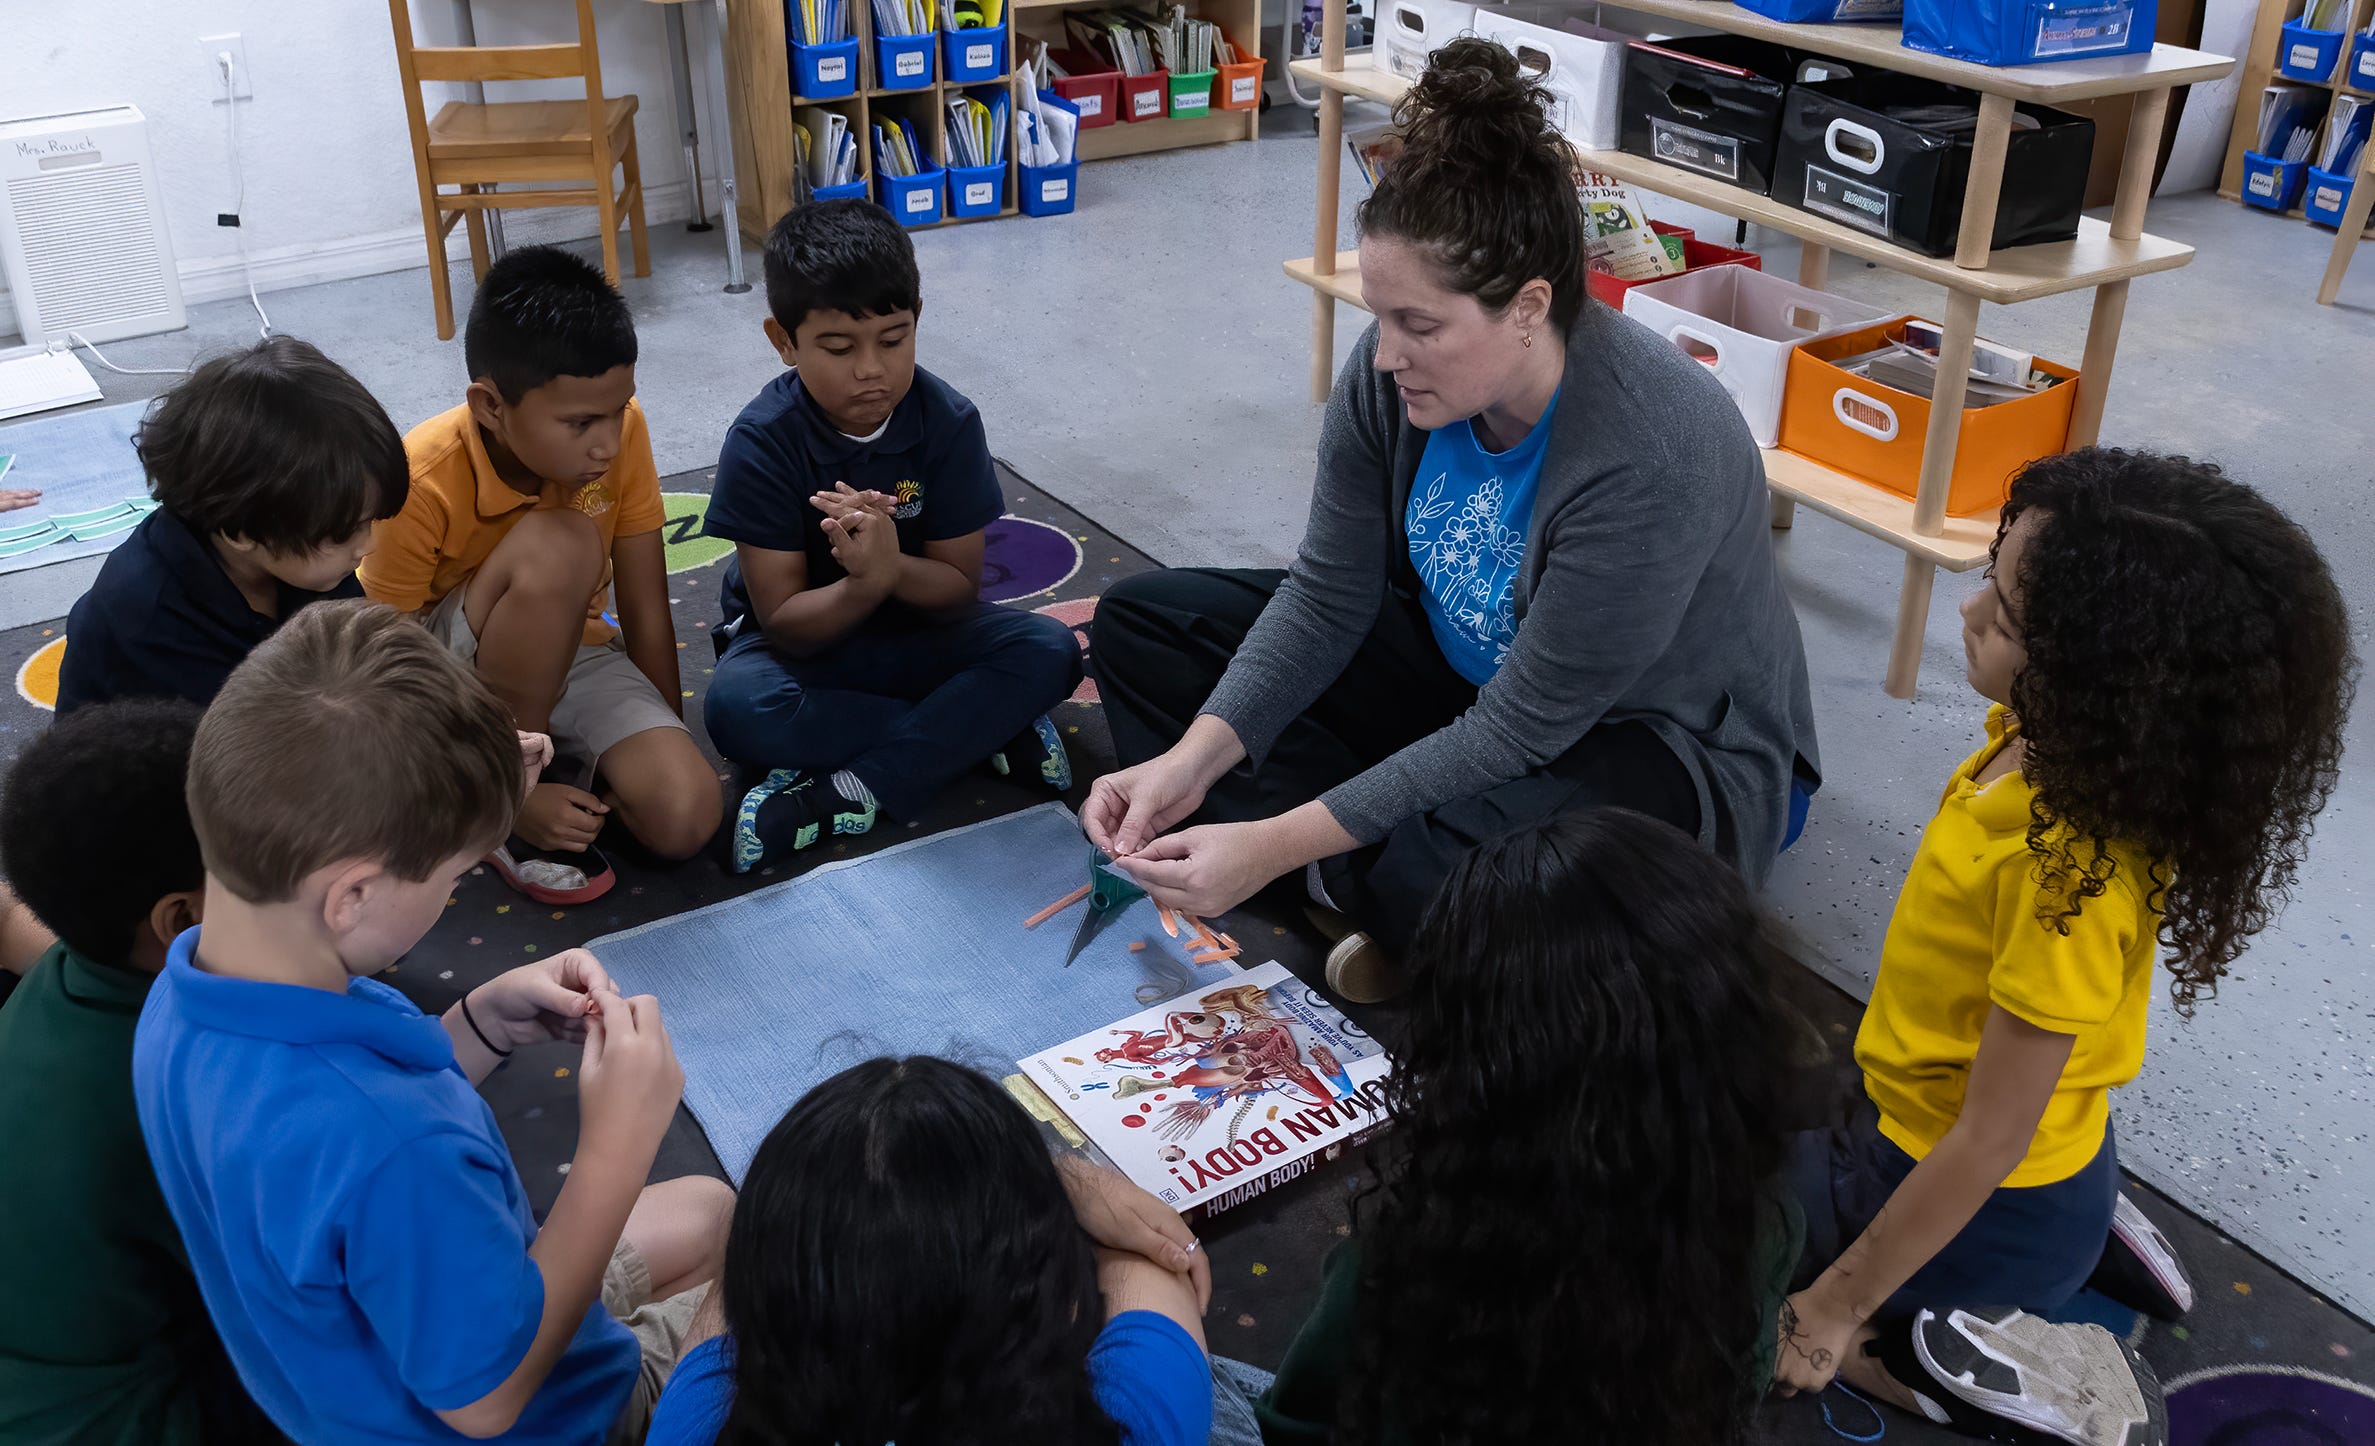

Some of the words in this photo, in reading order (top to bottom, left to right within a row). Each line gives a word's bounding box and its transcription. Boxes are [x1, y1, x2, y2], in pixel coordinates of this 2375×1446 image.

[16, 143, 45, 157] Mrs.
[48, 136, 96, 154] Rauck
[1602, 188, 1626, 199] Dog
[1282, 1001, 1299, 1015] BODY
[1299, 1005, 1316, 1020] SEEN
[1297, 1012, 1325, 1035] AMAZING
[1314, 1018, 1335, 1034] NEVER
[1321, 1034, 1340, 1048] YOUR
[1333, 1033, 1354, 1050] YOU'VE
[1353, 1050, 1364, 1058] AS
[1037, 1059, 1074, 1094] Smithsonian
[1280, 1075, 1397, 1144] UMAN
[1169, 1127, 1289, 1194] BODY!
[1206, 1176, 1266, 1218] HUMAN
[1270, 1153, 1316, 1190] BODY!
